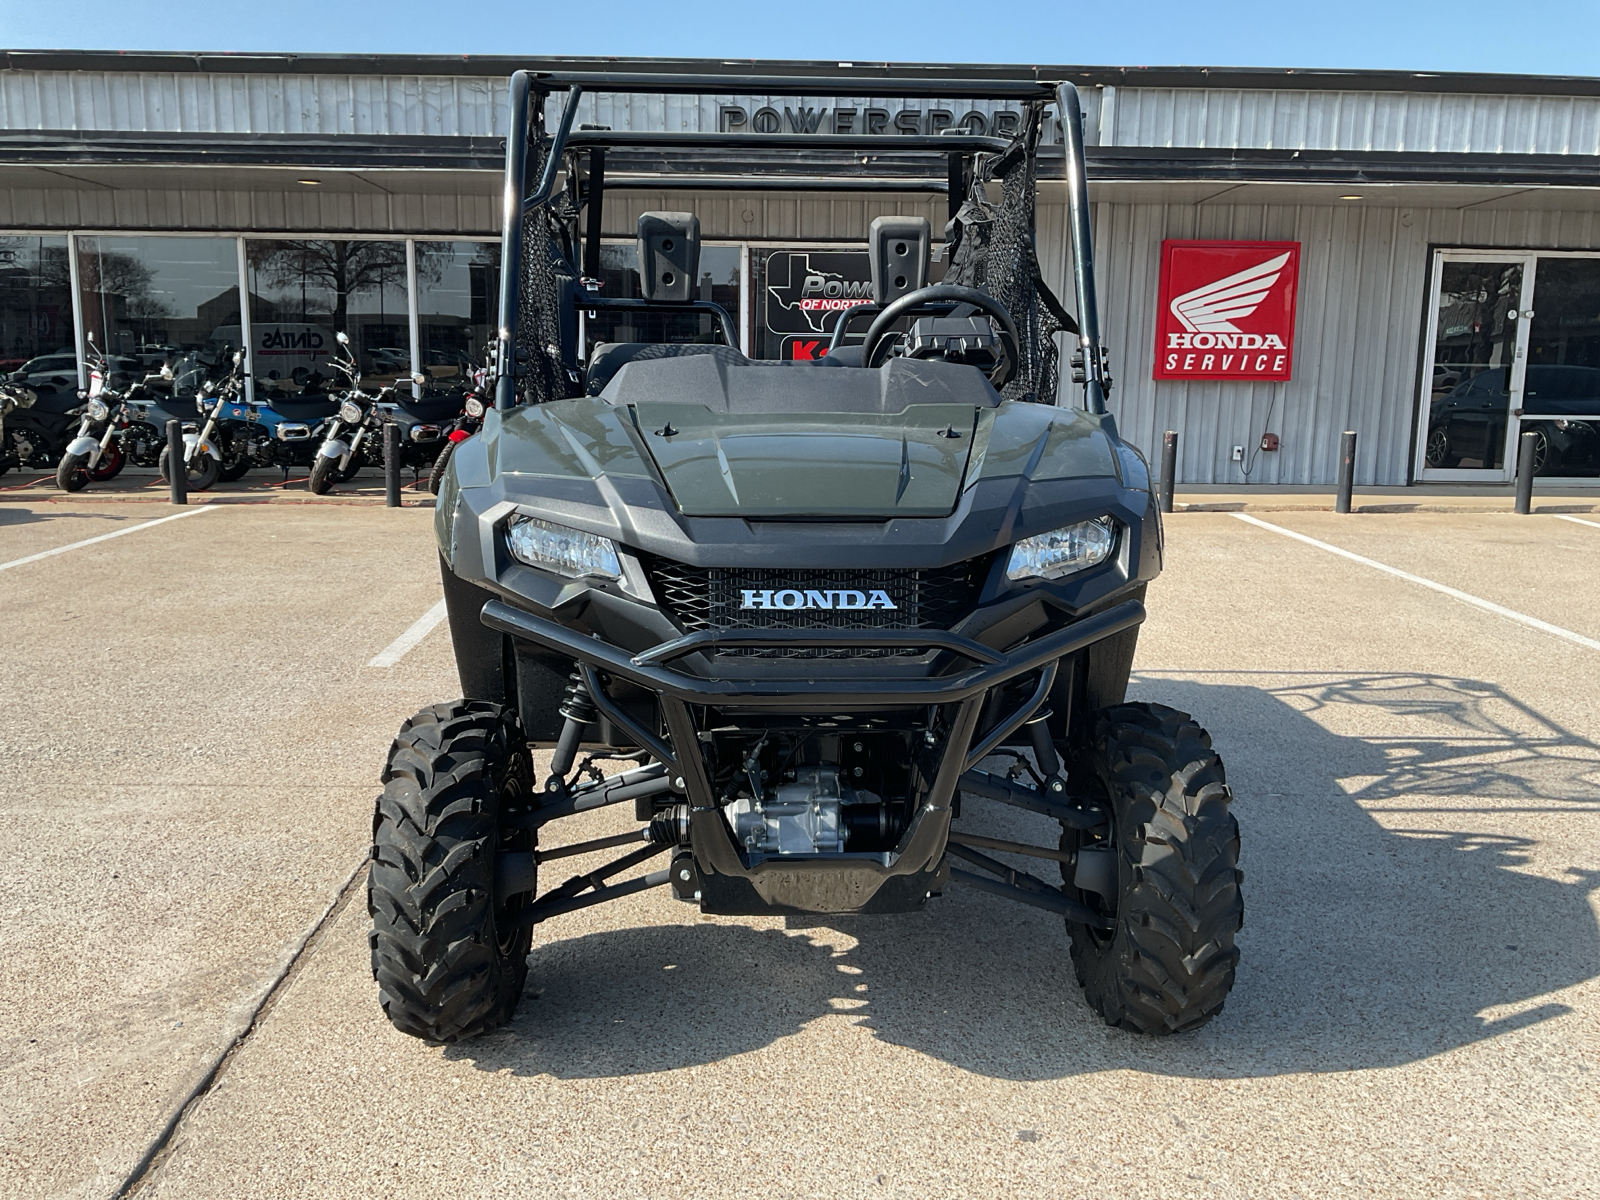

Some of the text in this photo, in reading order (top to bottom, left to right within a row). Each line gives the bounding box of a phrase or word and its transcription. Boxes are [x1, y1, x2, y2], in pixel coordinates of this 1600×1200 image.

[802, 300, 819, 309] OF
[1166, 333, 1287, 349] HONDA
[1165, 353, 1286, 371] SERVICE
[740, 589, 898, 610] HONDA
